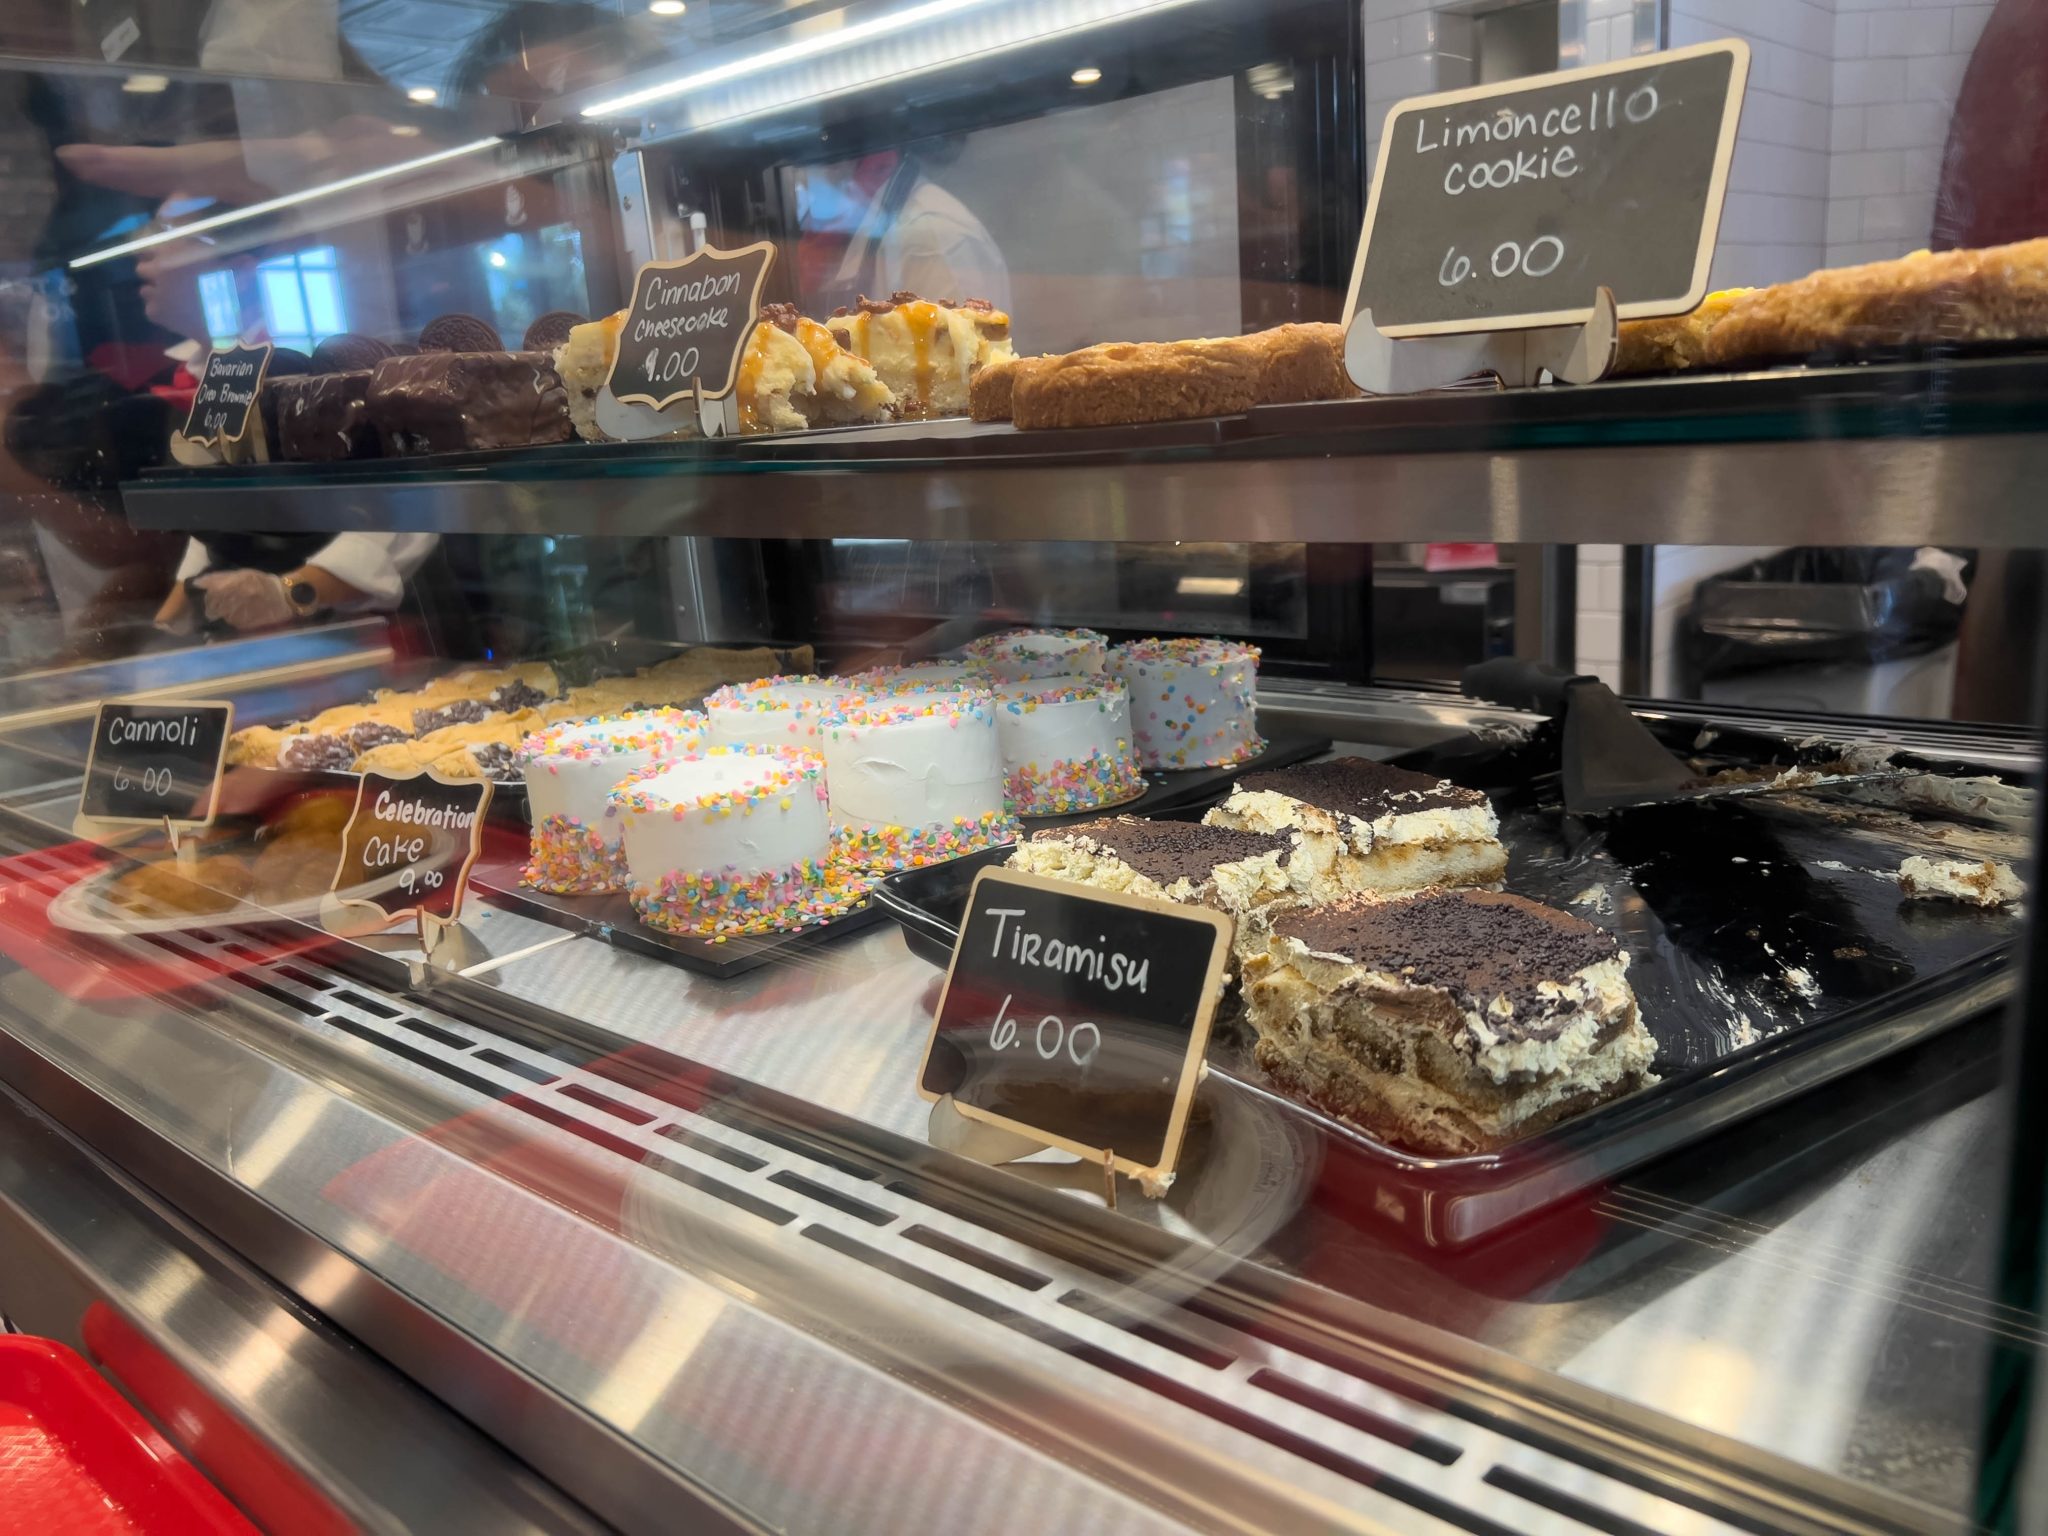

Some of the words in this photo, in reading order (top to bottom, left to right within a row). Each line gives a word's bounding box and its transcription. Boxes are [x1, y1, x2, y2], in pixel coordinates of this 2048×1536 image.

[1415, 85, 1659, 154] Limoncello
[1437, 235, 1565, 287] 6.00
[644, 271, 741, 311] Cinnabon
[209, 357, 254, 378] Bavarian
[197, 383, 217, 405] Oreo
[108, 715, 199, 746] Cannoli
[113, 765, 172, 797] 6.00
[373, 789, 476, 830] Celebration
[362, 834, 425, 867] Cake
[399, 867, 444, 896] 9.00
[989, 993, 1101, 1066] 6.00
